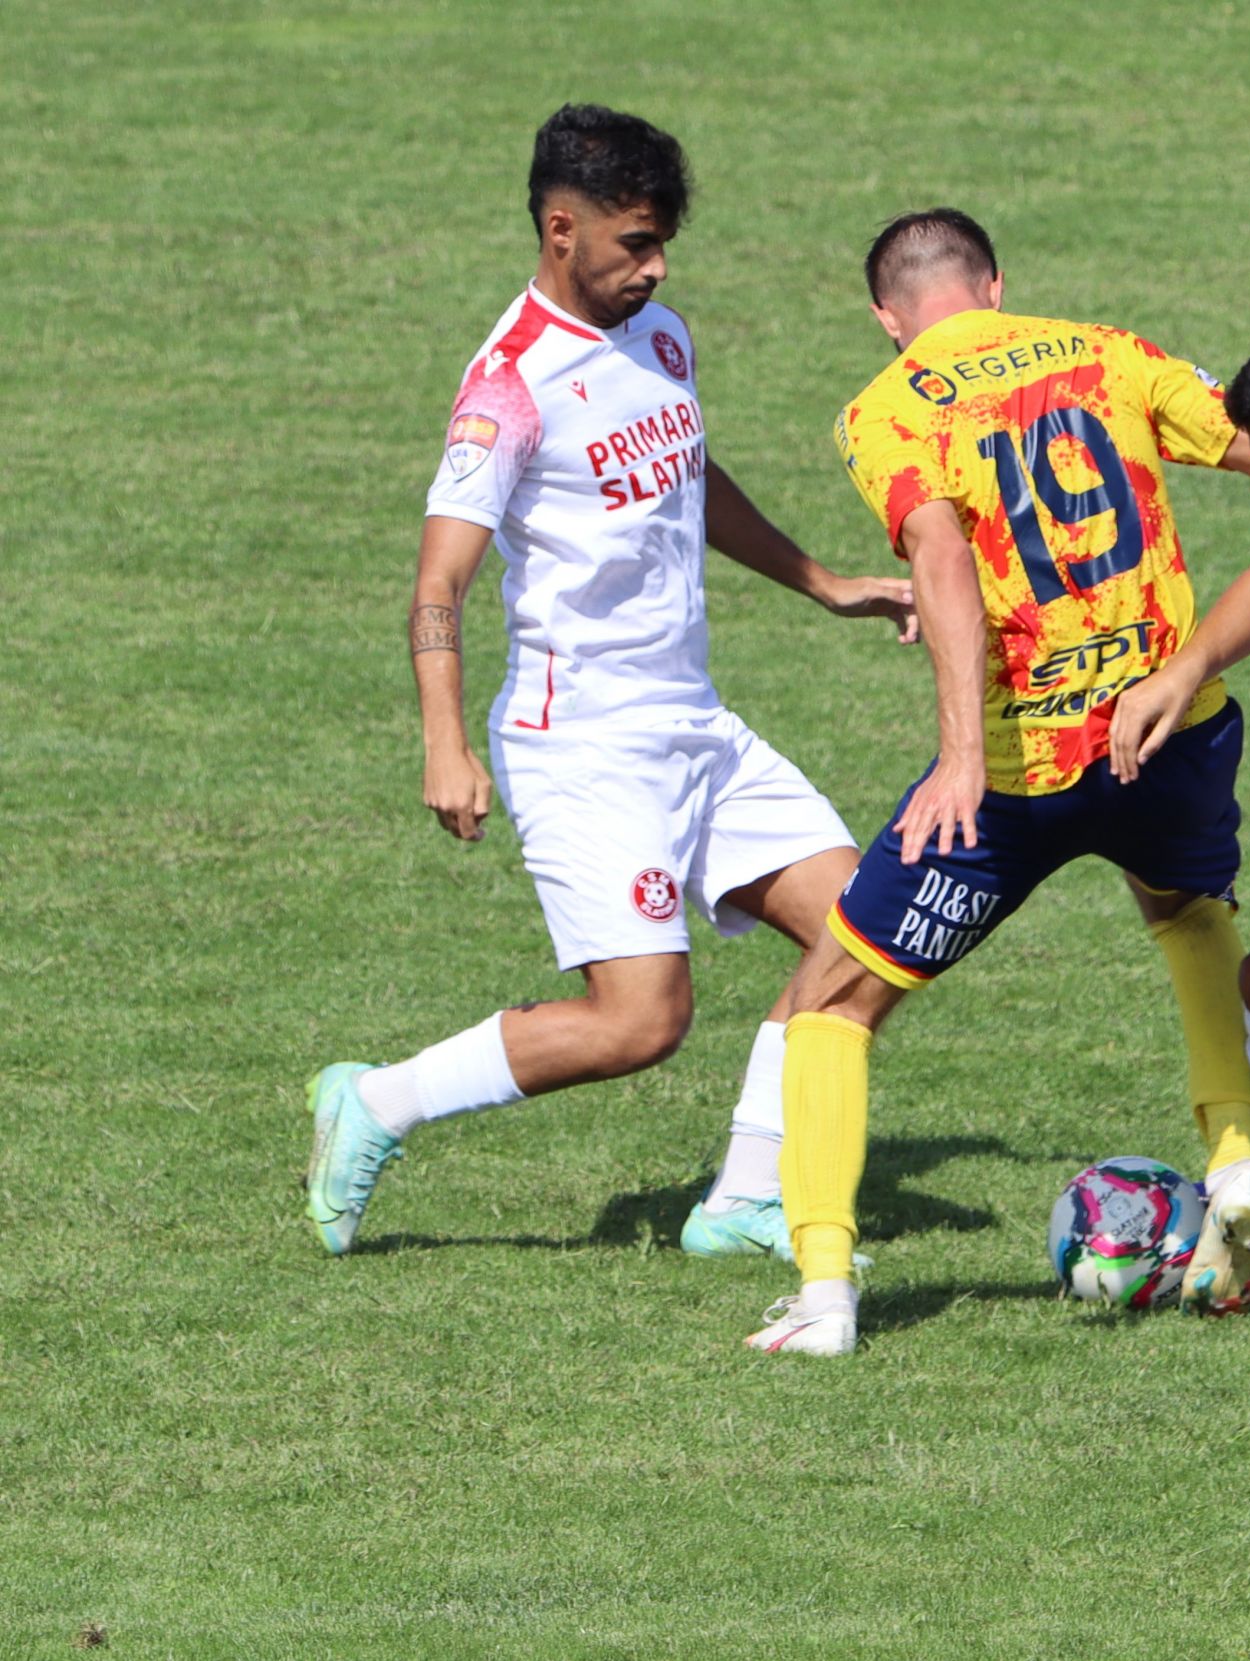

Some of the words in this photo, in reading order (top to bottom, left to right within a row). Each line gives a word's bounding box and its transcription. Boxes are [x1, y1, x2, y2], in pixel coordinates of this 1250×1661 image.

[953, 336, 1086, 381] EGERIA
[600, 441, 703, 511] SLATIN
[976, 406, 1145, 606] 19
[1002, 675, 1158, 719] DUCO
